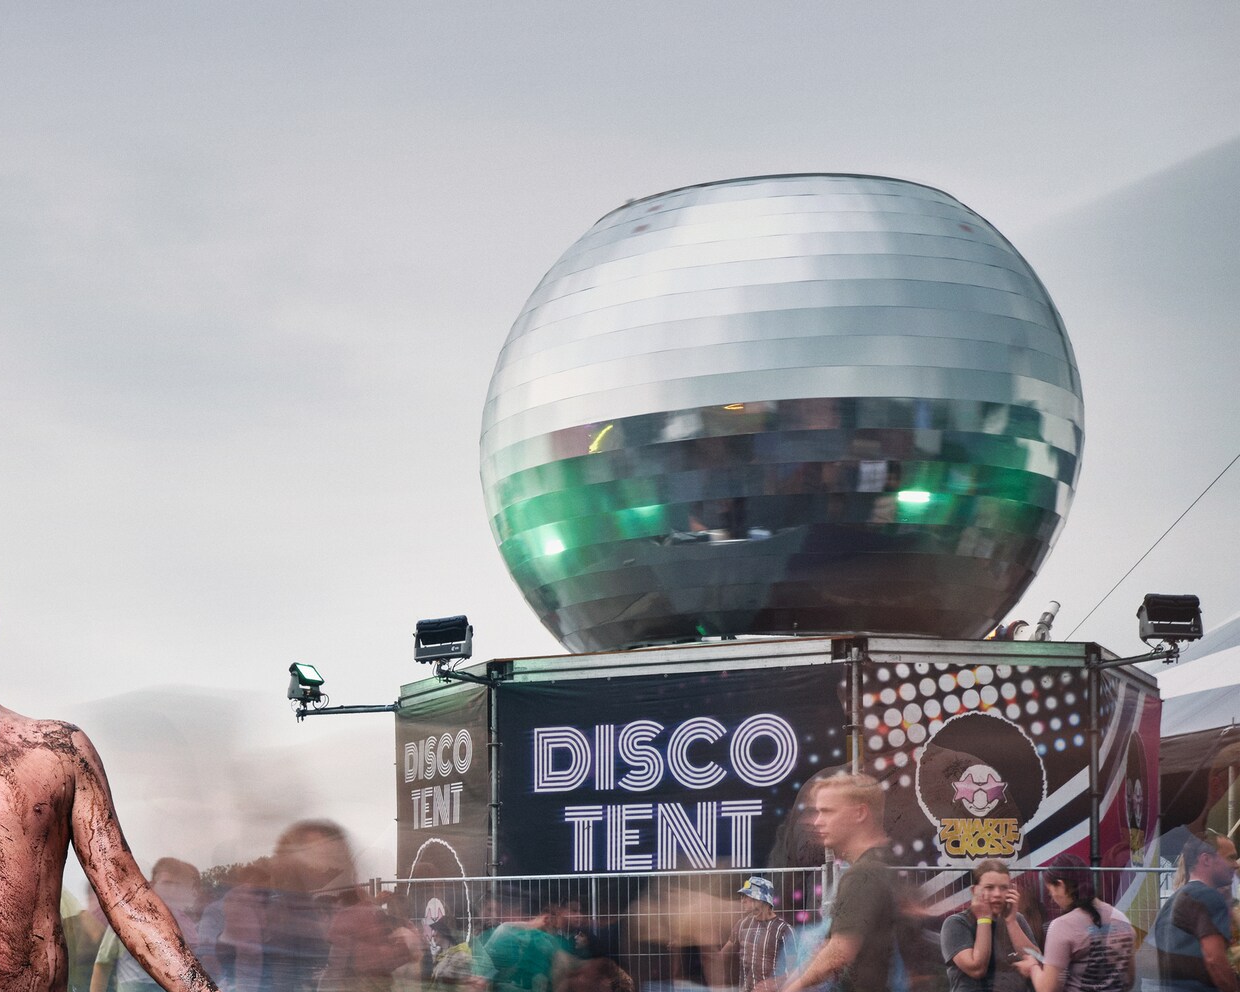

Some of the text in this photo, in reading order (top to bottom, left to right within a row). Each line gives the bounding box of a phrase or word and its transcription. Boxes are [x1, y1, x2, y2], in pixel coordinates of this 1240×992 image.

[405, 729, 473, 783] DISCO
[534, 713, 798, 792] DISCO
[411, 782, 463, 830] TENT
[940, 818, 1019, 841] ZWARTE
[565, 800, 762, 871] TENT
[945, 836, 1015, 856] CROSS
